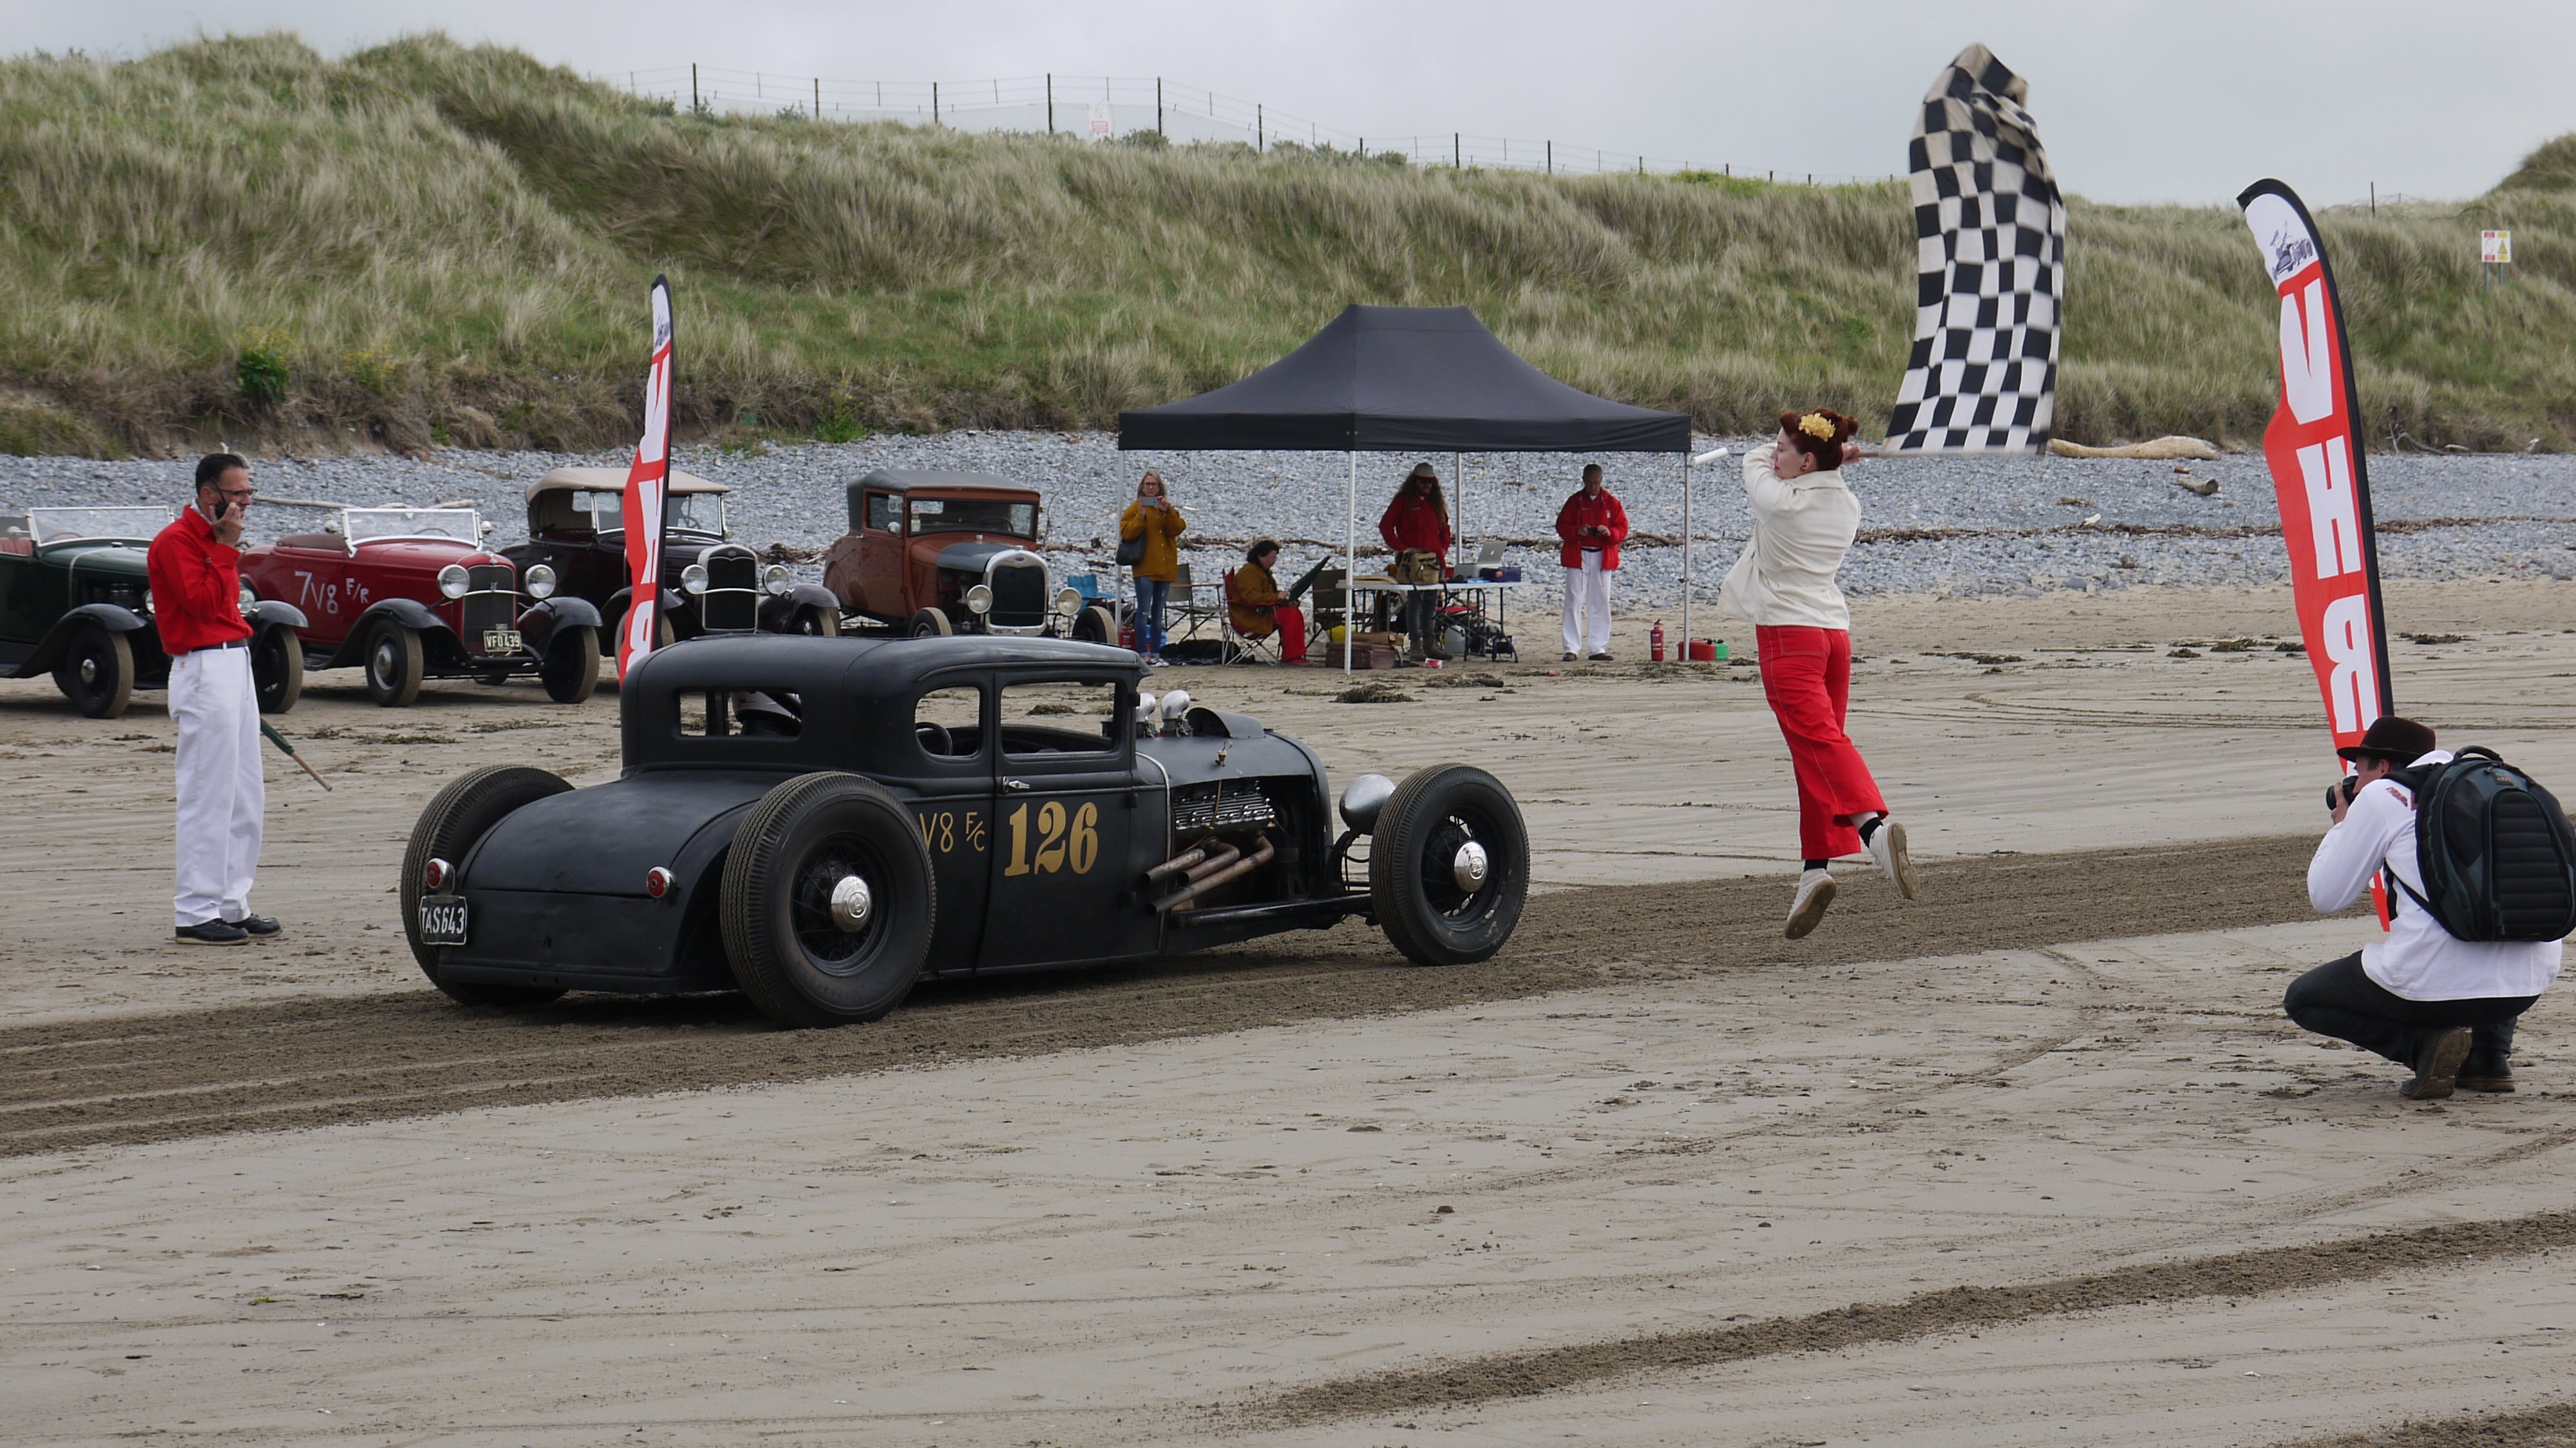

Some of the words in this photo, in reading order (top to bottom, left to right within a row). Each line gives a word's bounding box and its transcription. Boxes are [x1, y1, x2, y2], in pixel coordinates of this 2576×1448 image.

[346, 577, 369, 604] F/R
[919, 812, 953, 853] V8
[966, 812, 985, 852] F/C
[1004, 801, 1098, 877] 126
[422, 906, 464, 934] TAS643
